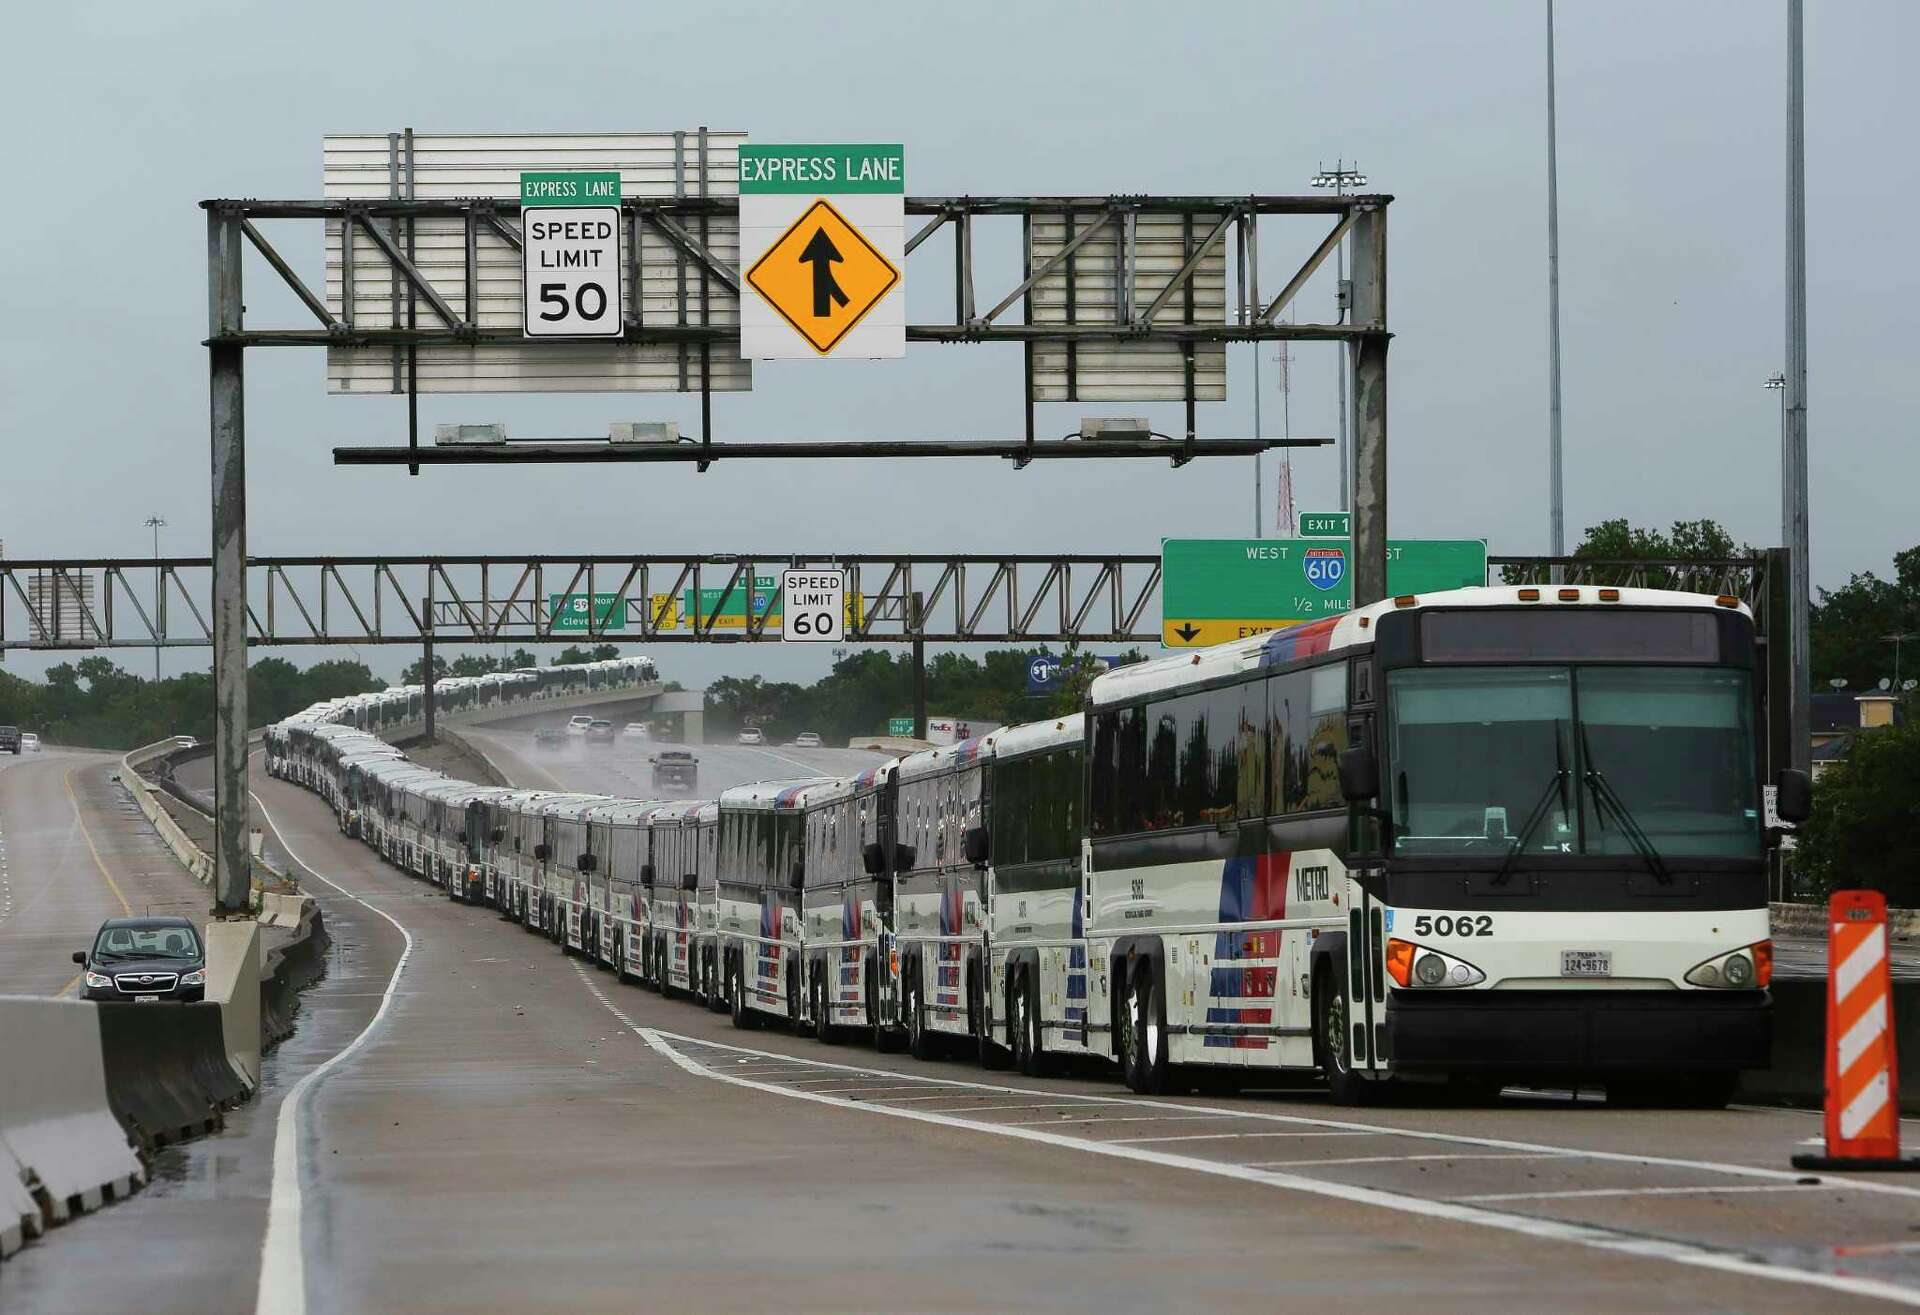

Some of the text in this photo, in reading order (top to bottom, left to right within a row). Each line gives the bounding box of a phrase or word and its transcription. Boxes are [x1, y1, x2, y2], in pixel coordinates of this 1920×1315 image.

[741, 156, 900, 181] EXPRESS LANE
[526, 181, 615, 197] EXPRESS LANE
[532, 222, 612, 240] SPEED
[541, 249, 604, 268] LIMIT
[539, 282, 607, 321] 50
[1308, 520, 1336, 530] EXIT
[1246, 547, 1288, 560] WEST
[1308, 559, 1342, 580] 610
[788, 577, 839, 589] SPEED
[575, 601, 587, 609] 59
[594, 597, 616, 605] NORT
[793, 594, 833, 605] LIMIT
[793, 612, 833, 635] 60
[930, 723, 953, 732] FedEx
[1296, 865, 1330, 902] METRO
[1414, 915, 1494, 937] 5062
